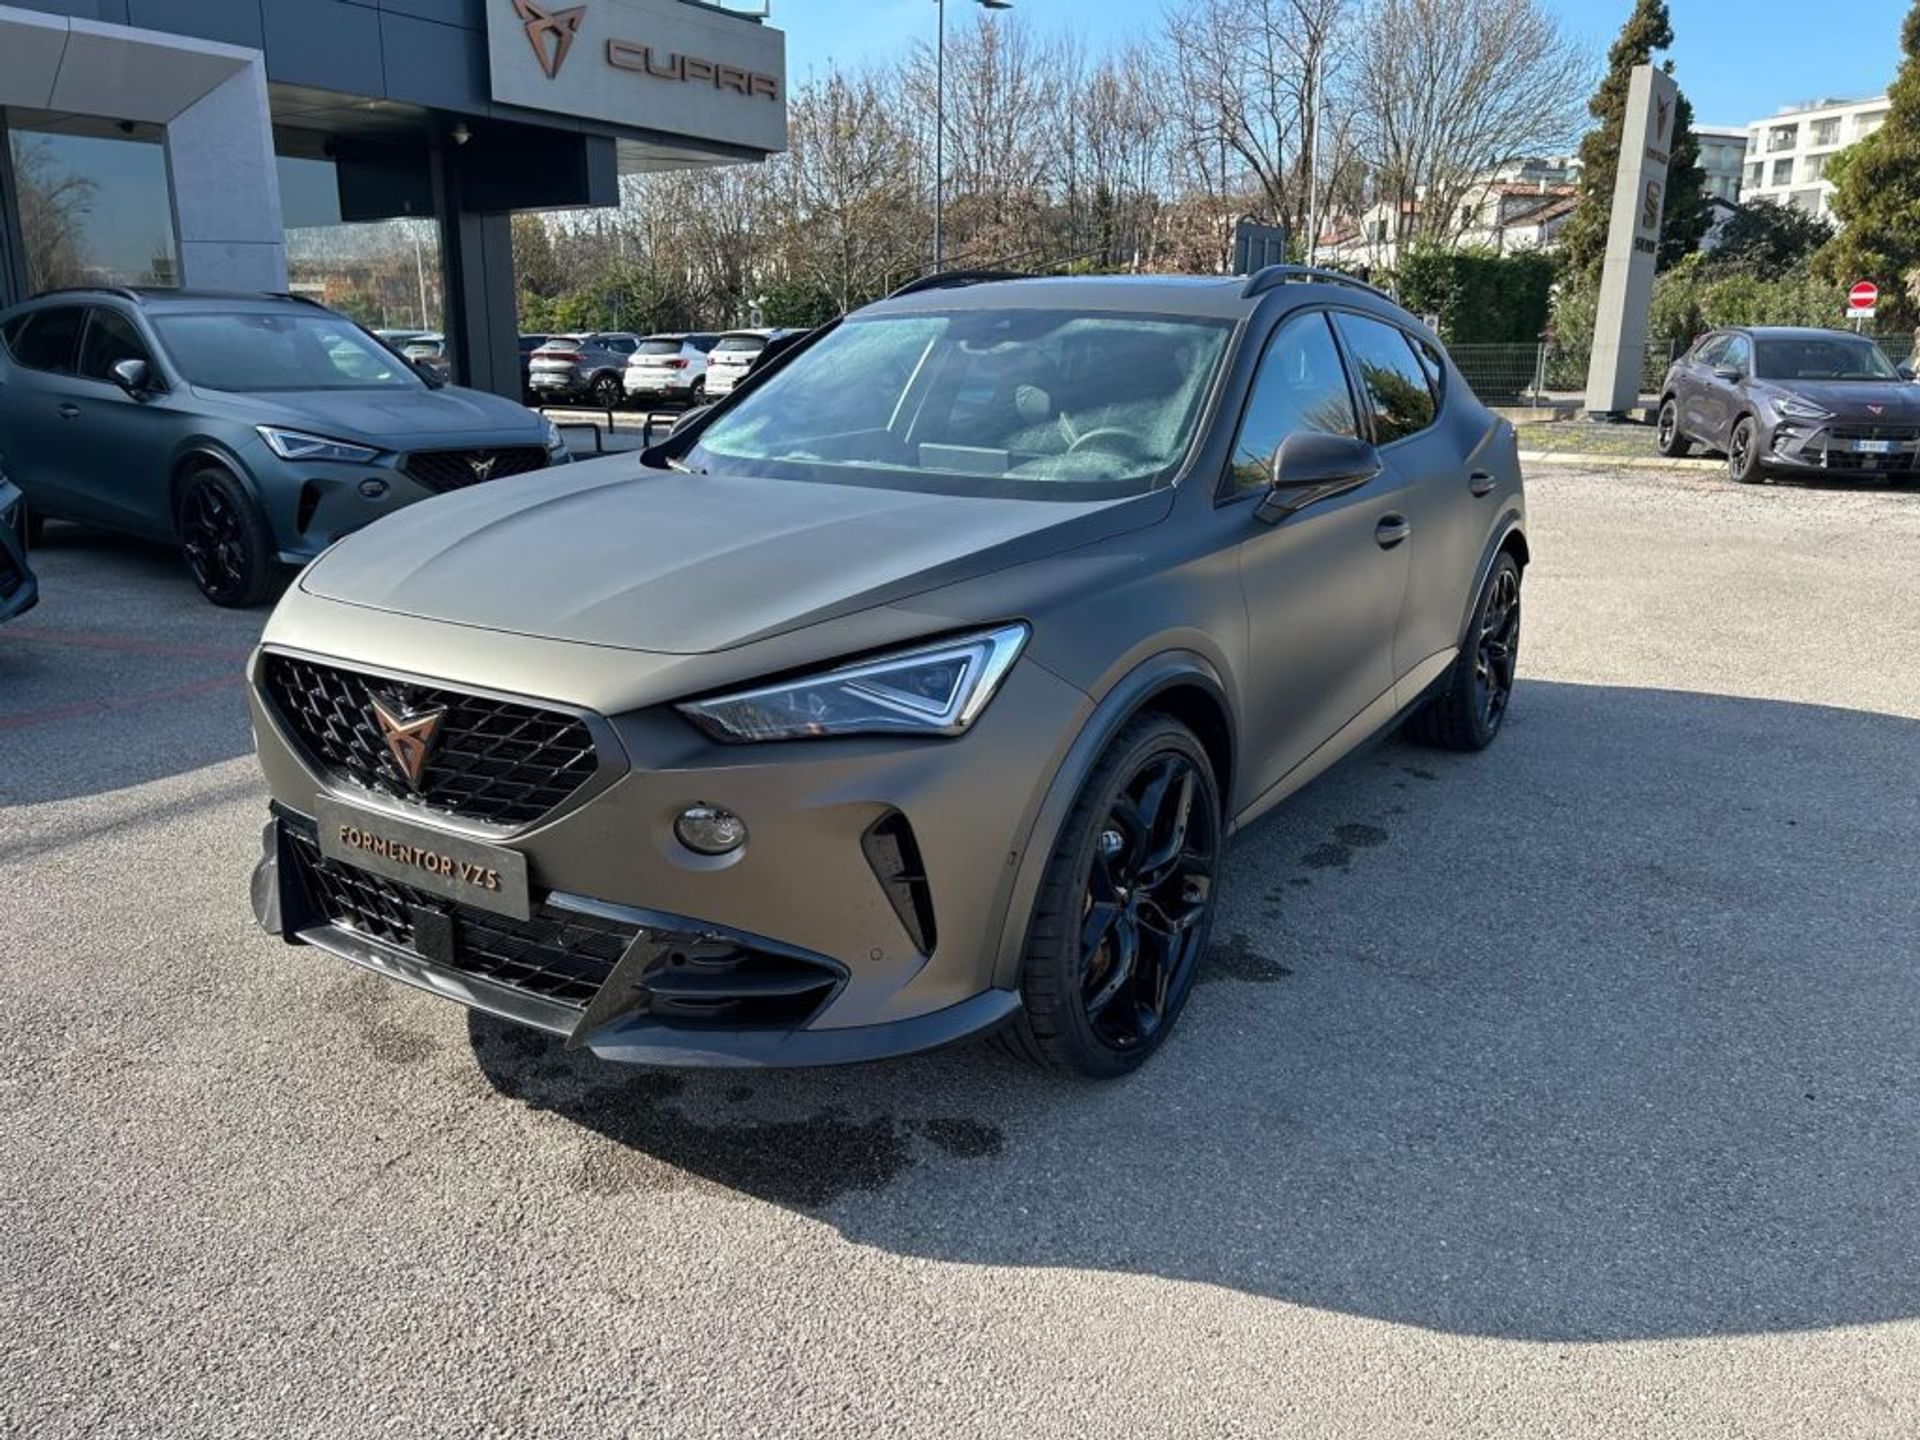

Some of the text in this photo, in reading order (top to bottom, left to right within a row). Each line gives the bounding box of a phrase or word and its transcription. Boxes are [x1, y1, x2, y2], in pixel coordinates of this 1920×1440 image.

[607, 38, 780, 101] CUPRA
[338, 824, 498, 890] FORMENTOR VZ5
